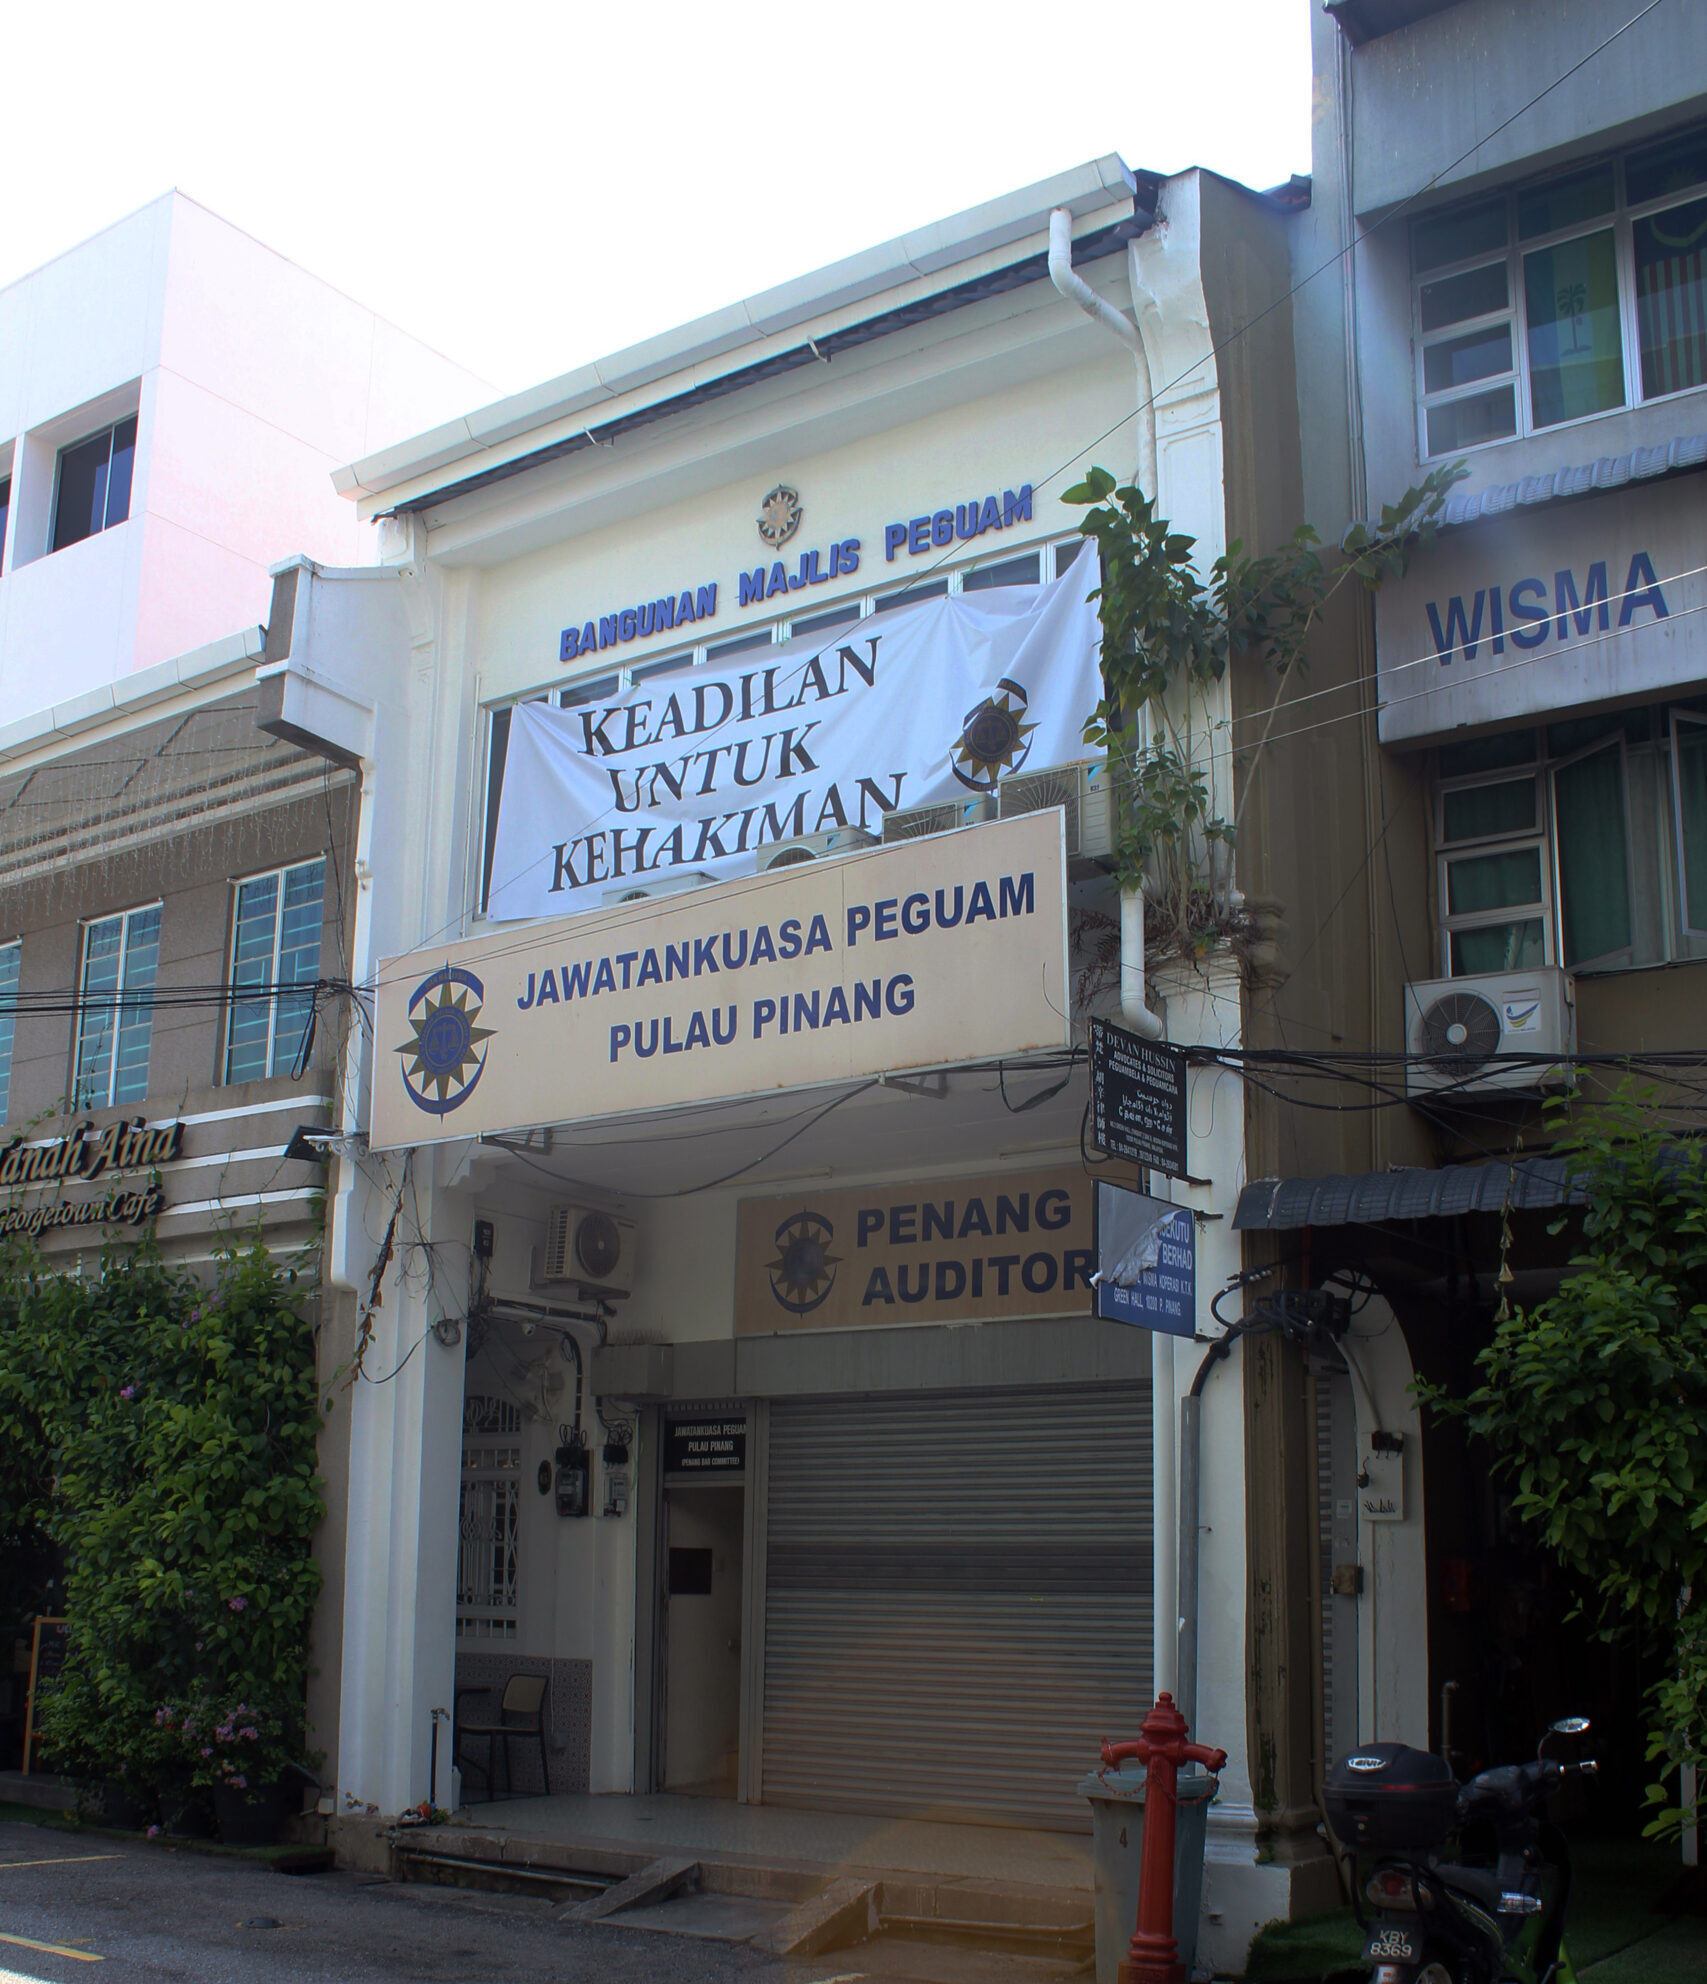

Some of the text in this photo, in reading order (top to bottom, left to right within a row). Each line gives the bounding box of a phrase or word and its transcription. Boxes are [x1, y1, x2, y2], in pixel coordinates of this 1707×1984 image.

[559, 483, 1034, 662] BANGUNAN MAJLIS PEGUAM
[1425, 551, 1670, 666] WISMA
[577, 635, 882, 757] KEADILAN
[606, 720, 822, 812] UNTUK
[548, 772, 907, 893] KEHAKIMAN
[517, 872, 1035, 1010] JAWATANKUASA PEGUAM
[609, 973, 915, 1063] PULAU PINANG
[1106, 1033, 1176, 1072] DEVAN HUSSIN
[857, 1189, 1072, 1247] PENANG
[1162, 1243, 1193, 1270] BERHAD
[1113, 1287, 1130, 1304] GREEN
[674, 1425, 721, 1437] JAWATANKUASA
[688, 1440, 734, 1452] PULAU PINANG
[1119, 1827, 1129, 1848] 4
[1369, 1941, 1412, 1958] 8369
[1379, 1928, 1409, 1945] KBY
